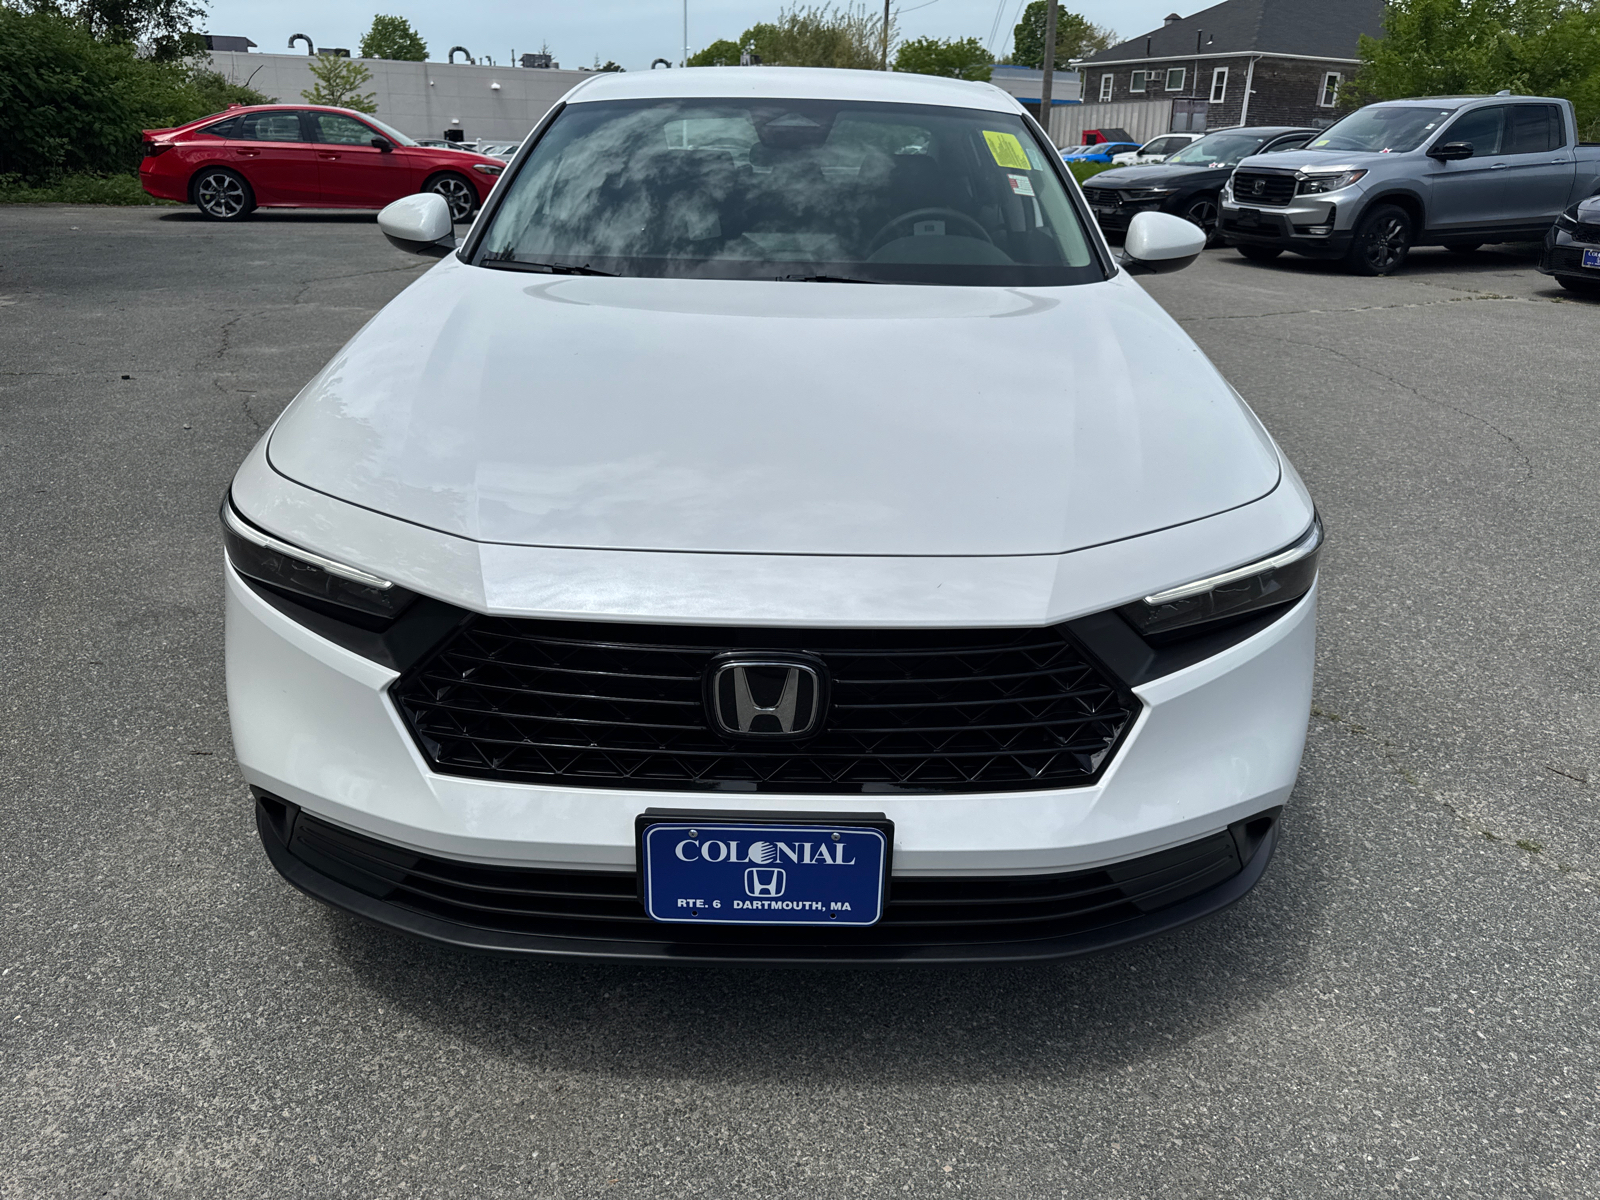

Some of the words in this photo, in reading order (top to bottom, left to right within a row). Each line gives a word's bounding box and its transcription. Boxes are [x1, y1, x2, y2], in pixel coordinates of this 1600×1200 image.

[675, 839, 856, 865] COLONIAL
[677, 898, 709, 908] RTE.
[712, 899, 722, 909] 6
[733, 900, 826, 912] DARTMOUTH,
[830, 901, 852, 911] MA
